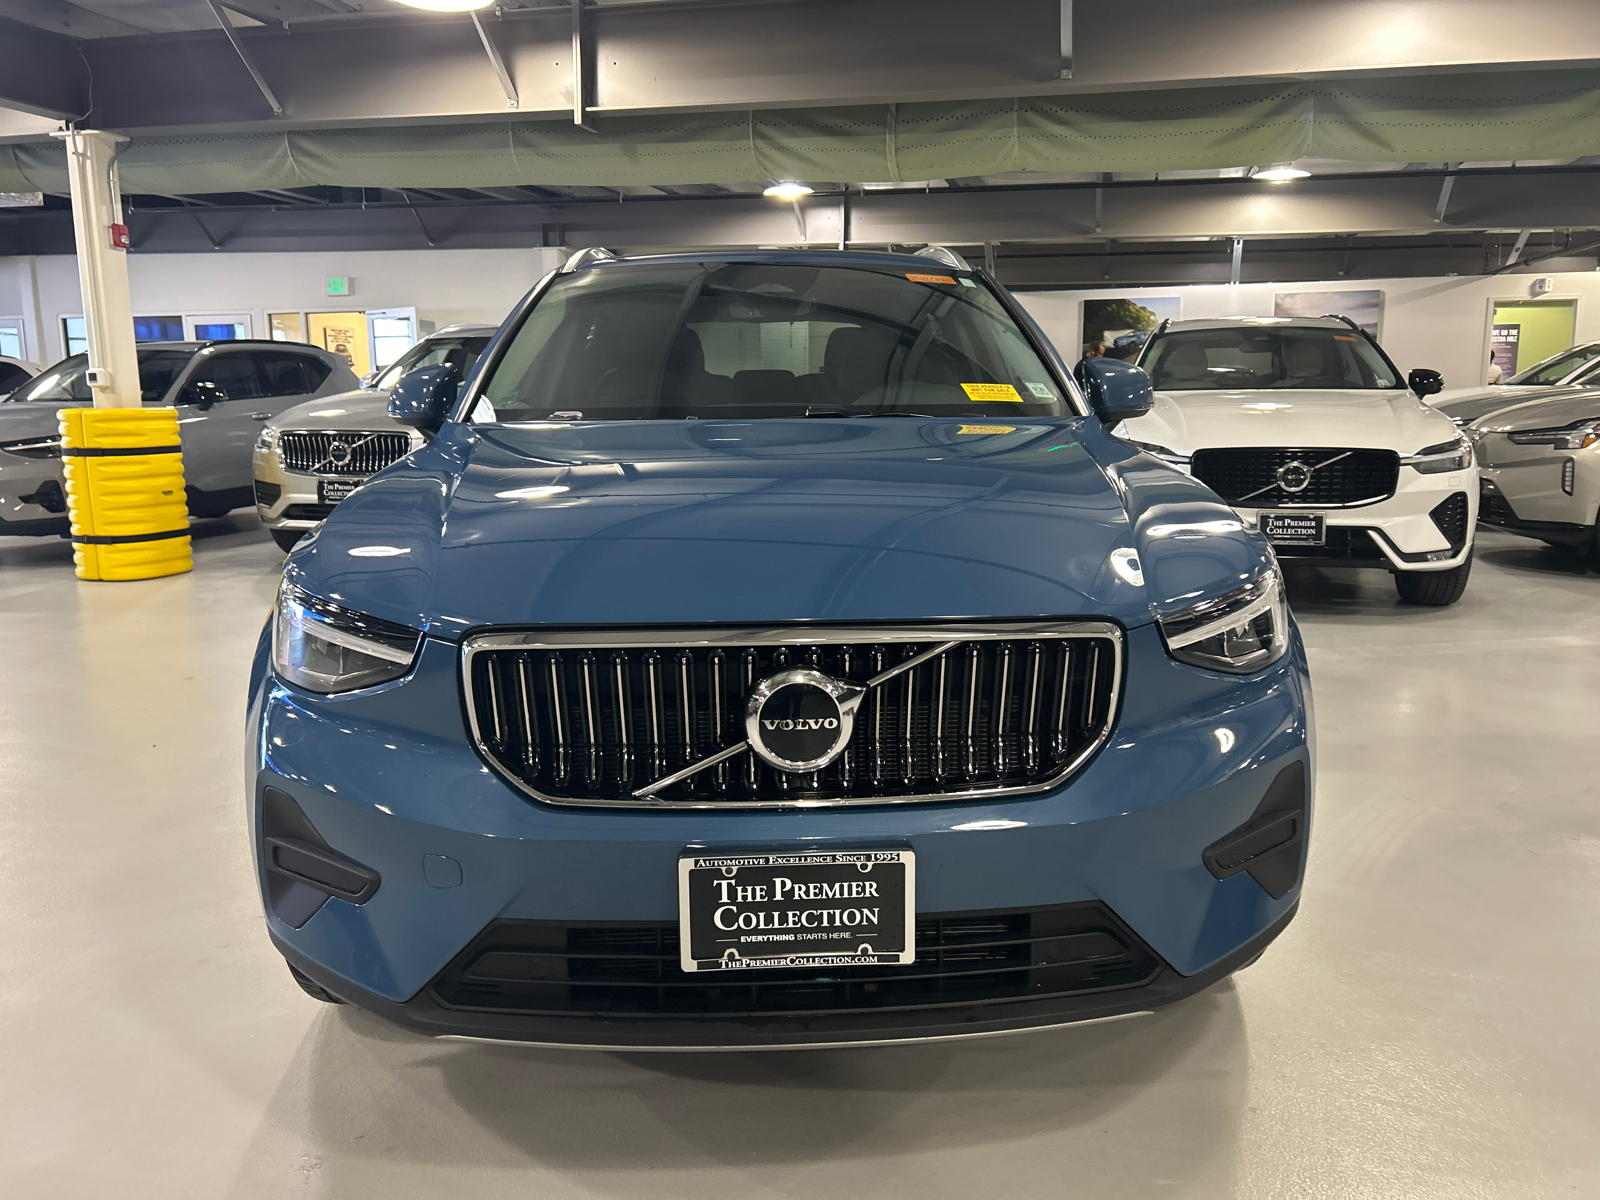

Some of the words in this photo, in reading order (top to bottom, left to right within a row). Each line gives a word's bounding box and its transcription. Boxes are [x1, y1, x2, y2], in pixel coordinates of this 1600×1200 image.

[1266, 526, 1316, 534] COLLECTION
[762, 717, 838, 731] VOLVO
[697, 858, 766, 867] AUTOMOTIVE
[768, 855, 832, 865] EXCELLENCE
[835, 854, 866, 863] SINCE
[870, 853, 898, 862] 1995
[713, 878, 768, 903] THE
[772, 877, 879, 901] PREMIER
[713, 905, 880, 931] COLLECTION
[741, 934, 795, 942] EVERYTHING
[796, 932, 827, 940] STARTS
[829, 931, 853, 939] HERE.
[719, 956, 878, 969] THEPREMIERCOLLECTION.COM
